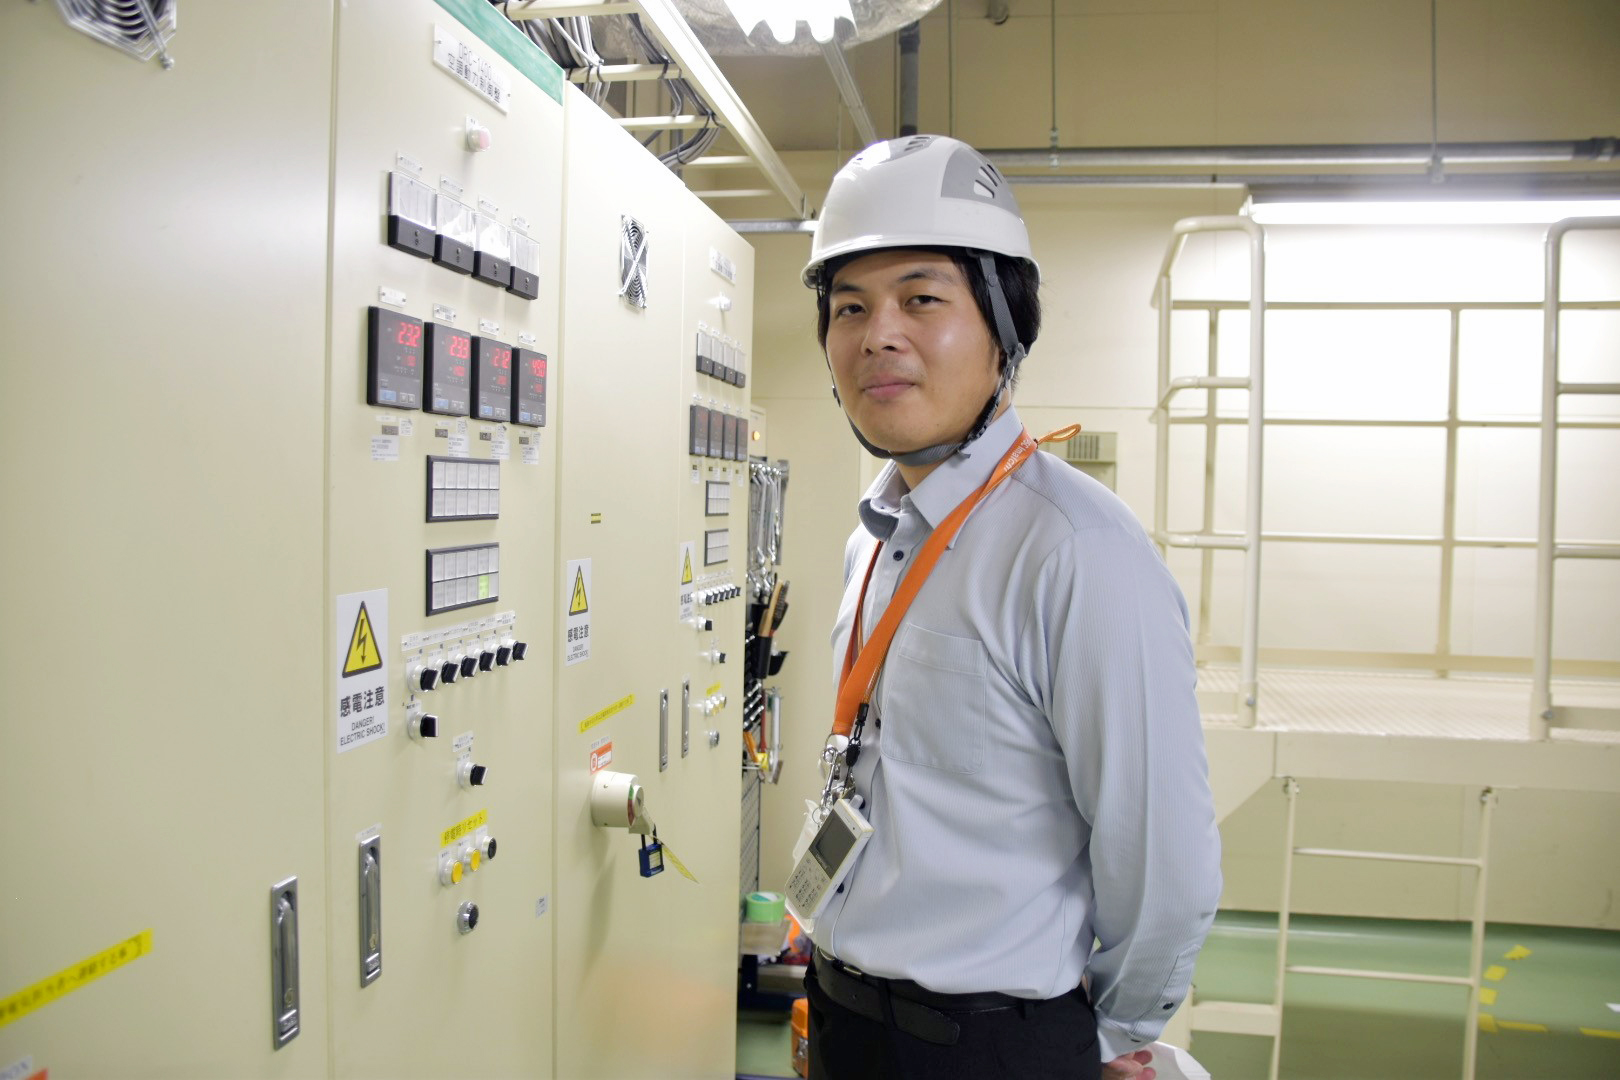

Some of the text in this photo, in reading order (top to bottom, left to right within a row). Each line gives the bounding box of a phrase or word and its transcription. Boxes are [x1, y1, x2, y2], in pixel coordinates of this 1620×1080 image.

[340, 686, 384, 717] 感電注意
[340, 730, 366, 746] ELECTRIC
